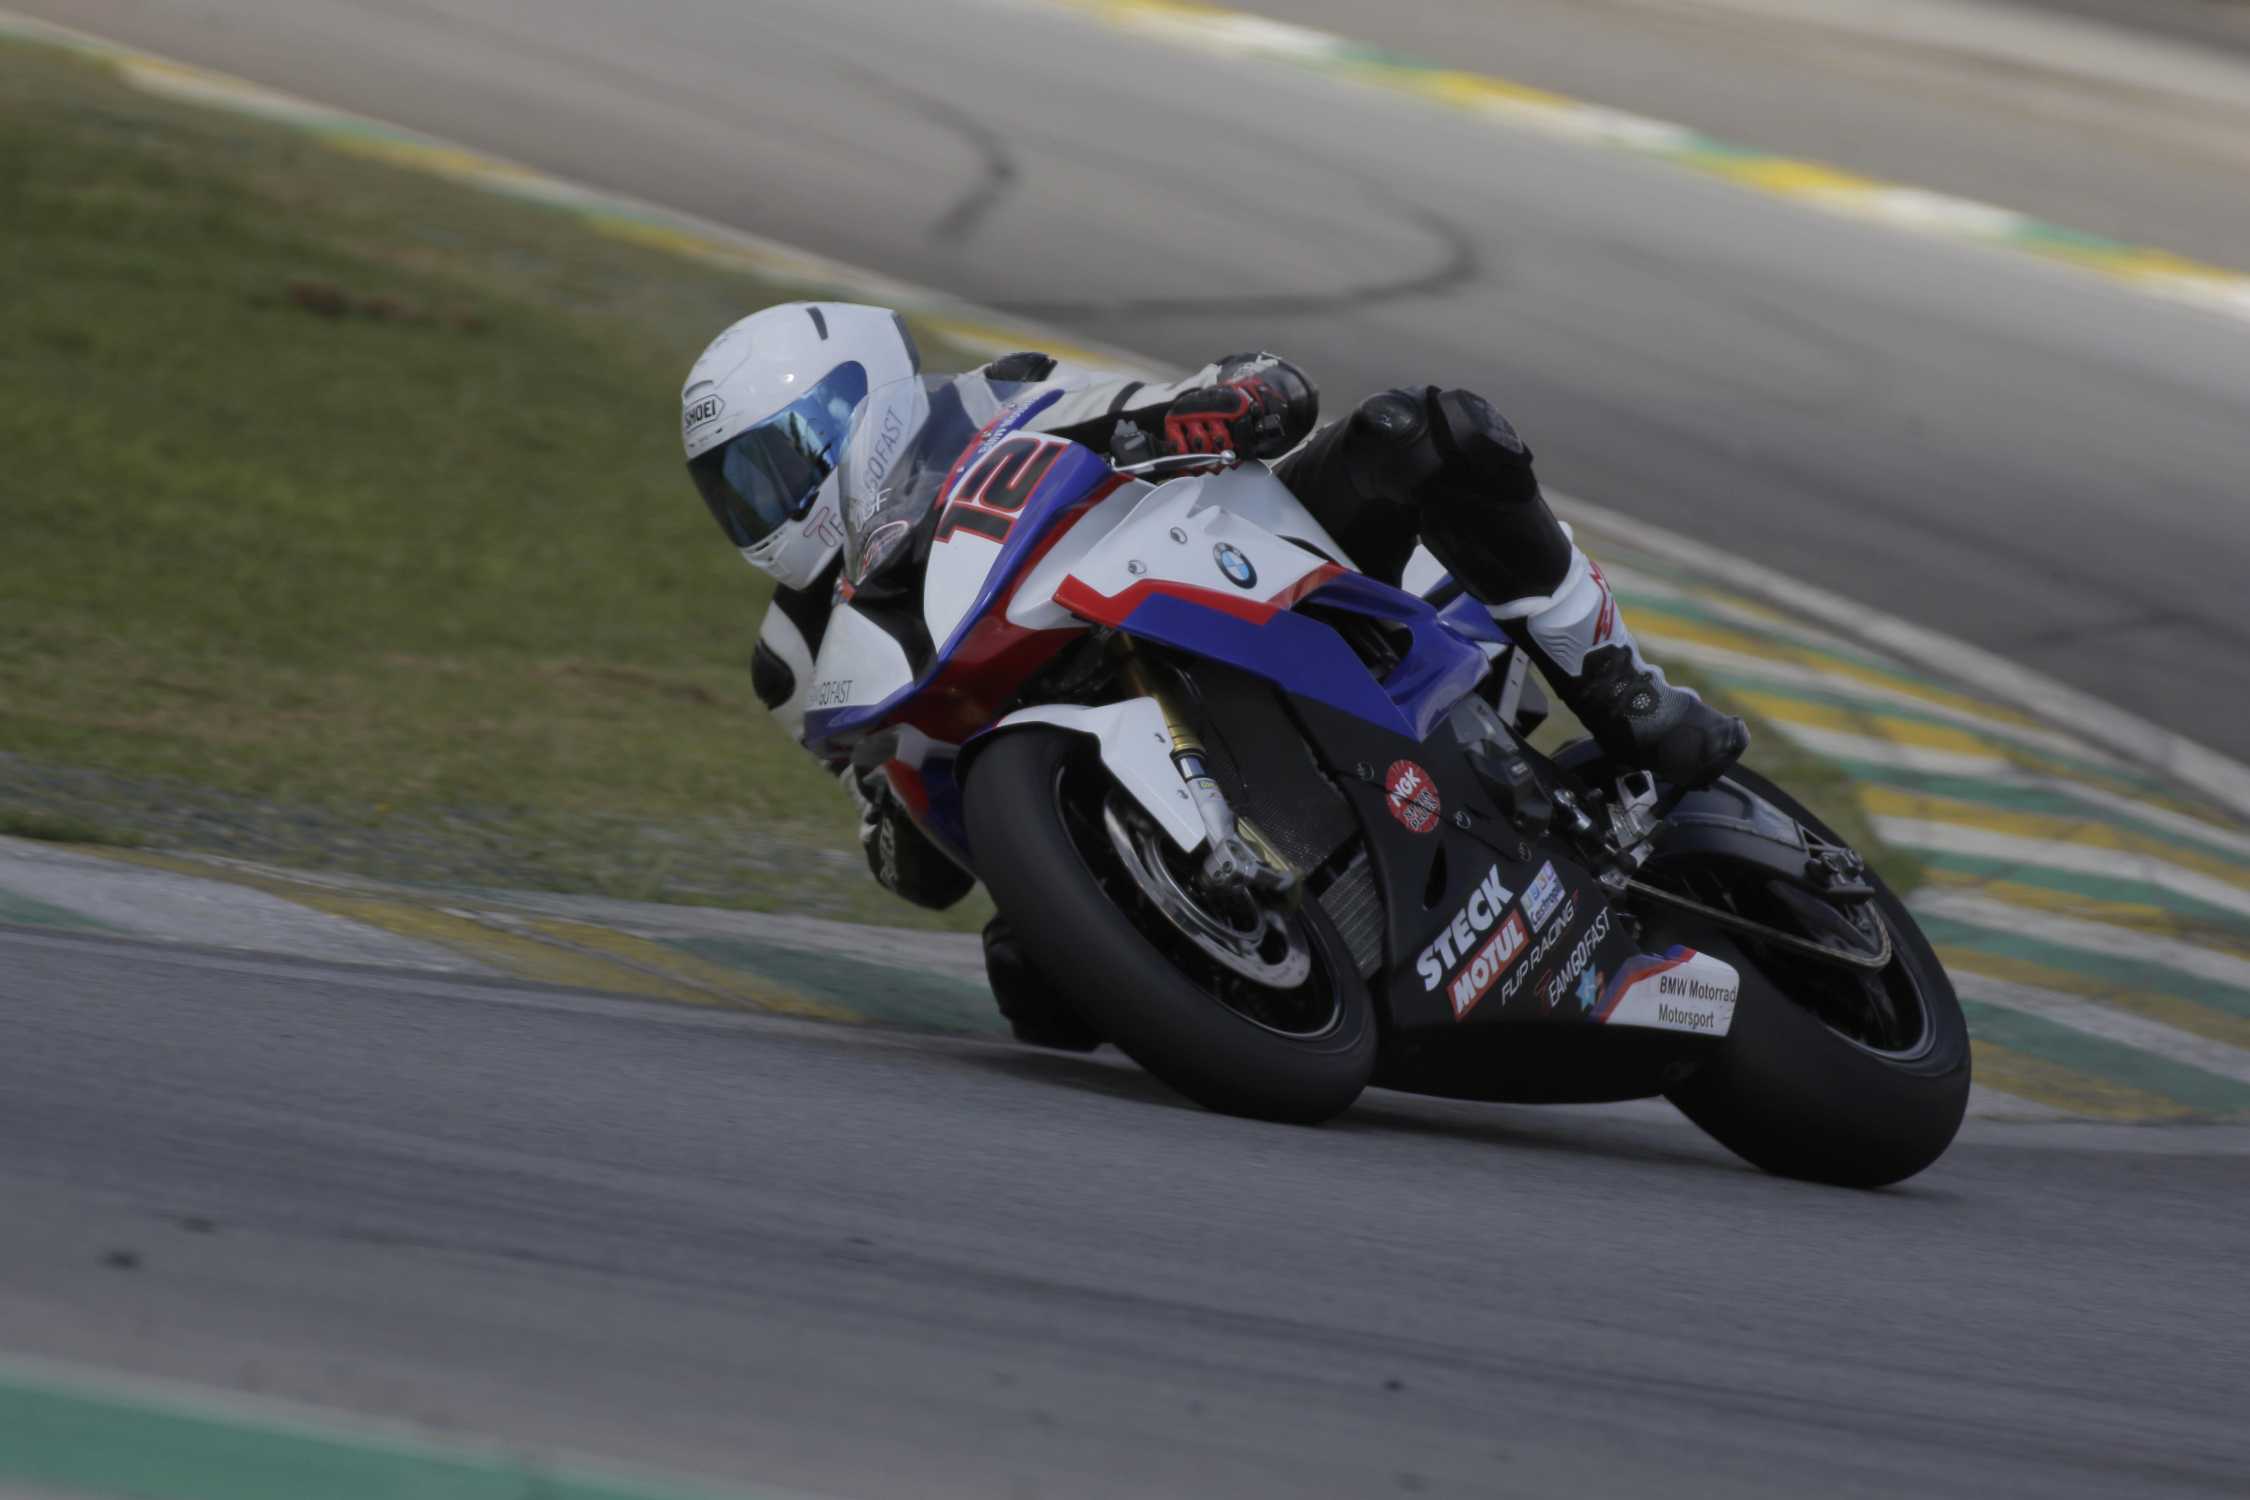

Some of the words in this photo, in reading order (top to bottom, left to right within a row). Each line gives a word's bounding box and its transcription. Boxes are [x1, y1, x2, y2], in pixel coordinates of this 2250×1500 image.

[932, 437, 1069, 545] 12
[1391, 767, 1421, 807] NGK
[1416, 863, 1514, 992] STECK
[1529, 899, 1575, 971] RACING
[1453, 919, 1525, 1014] MOTUL
[1660, 975, 1688, 997] BMW
[1689, 979, 1737, 1003] Motorrad
[1658, 1003, 1714, 1030] Motorsport
